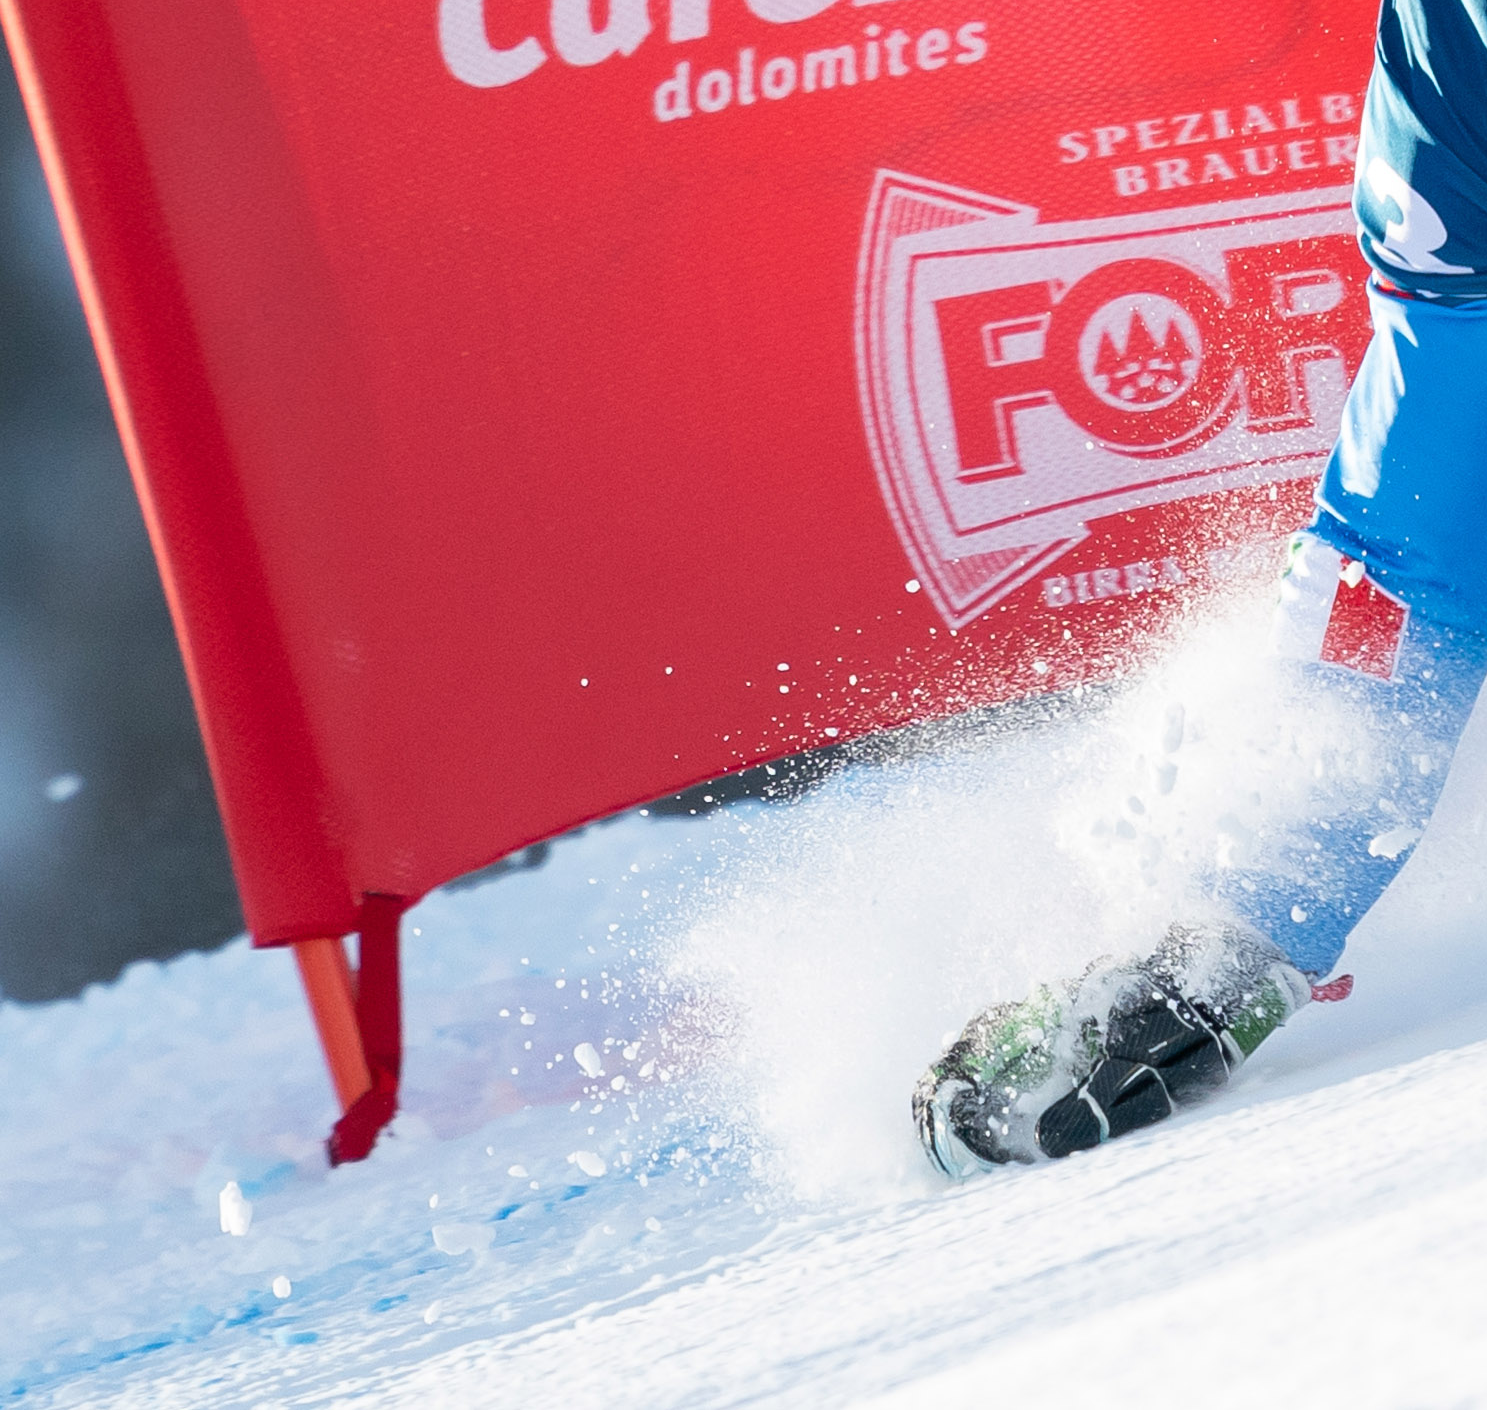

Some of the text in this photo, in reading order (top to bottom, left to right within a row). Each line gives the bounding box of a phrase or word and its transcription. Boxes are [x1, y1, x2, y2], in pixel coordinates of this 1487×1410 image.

[652, 20, 989, 123] dolomites
[1057, 93, 1356, 164] SPEZIALB
[1110, 133, 1360, 197] BRAUER
